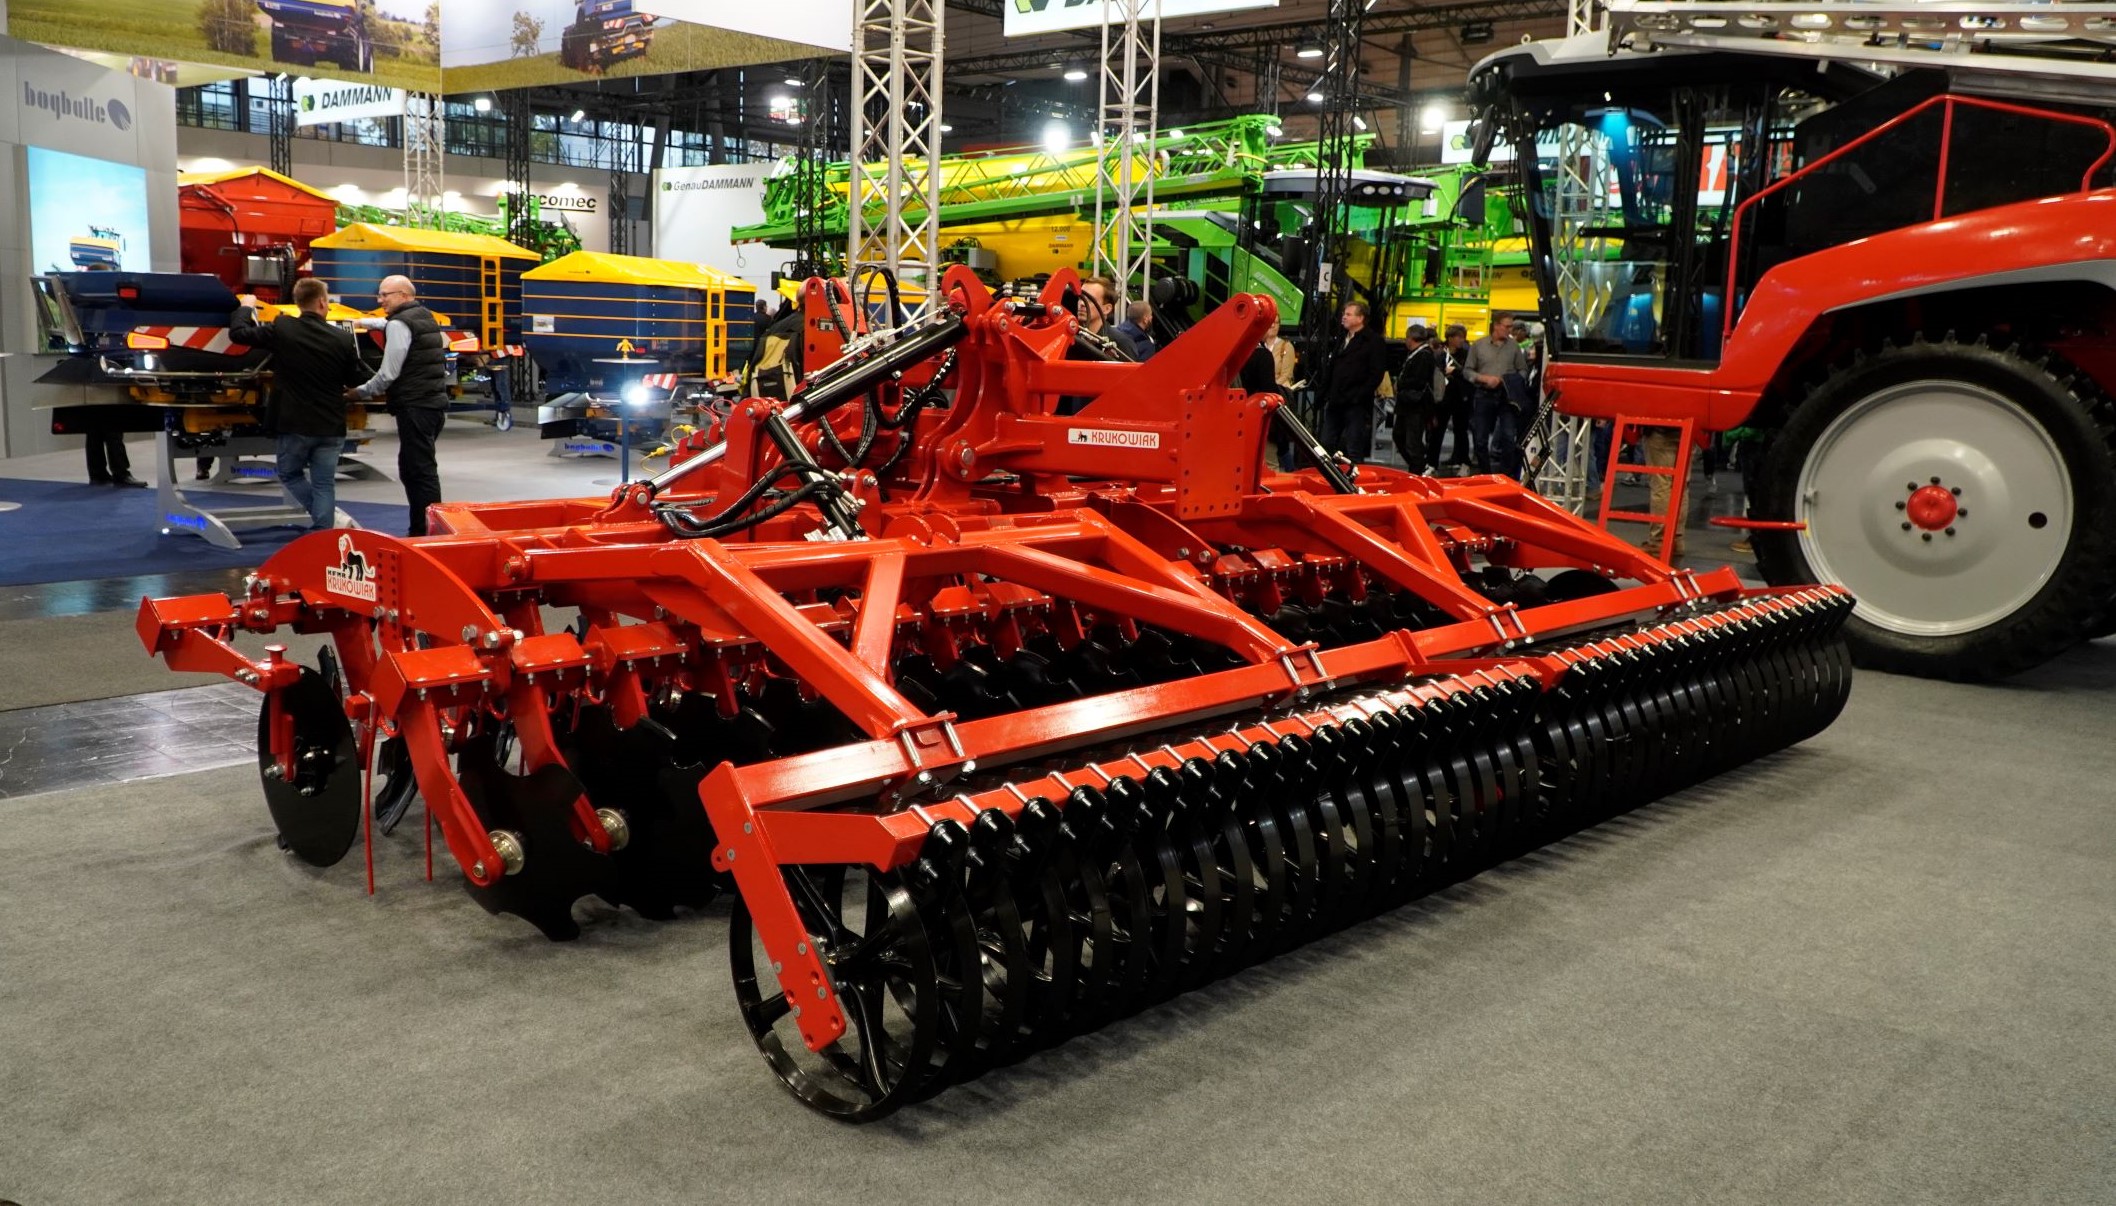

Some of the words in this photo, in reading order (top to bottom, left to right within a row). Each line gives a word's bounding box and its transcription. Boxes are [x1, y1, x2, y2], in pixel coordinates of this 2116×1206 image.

[321, 86, 392, 109] DAMMANN
[674, 178, 752, 191] GenauDAMMANN
[1091, 431, 1157, 446] KRUKOWIAK
[327, 577, 374, 598] KRUKOWIAK
